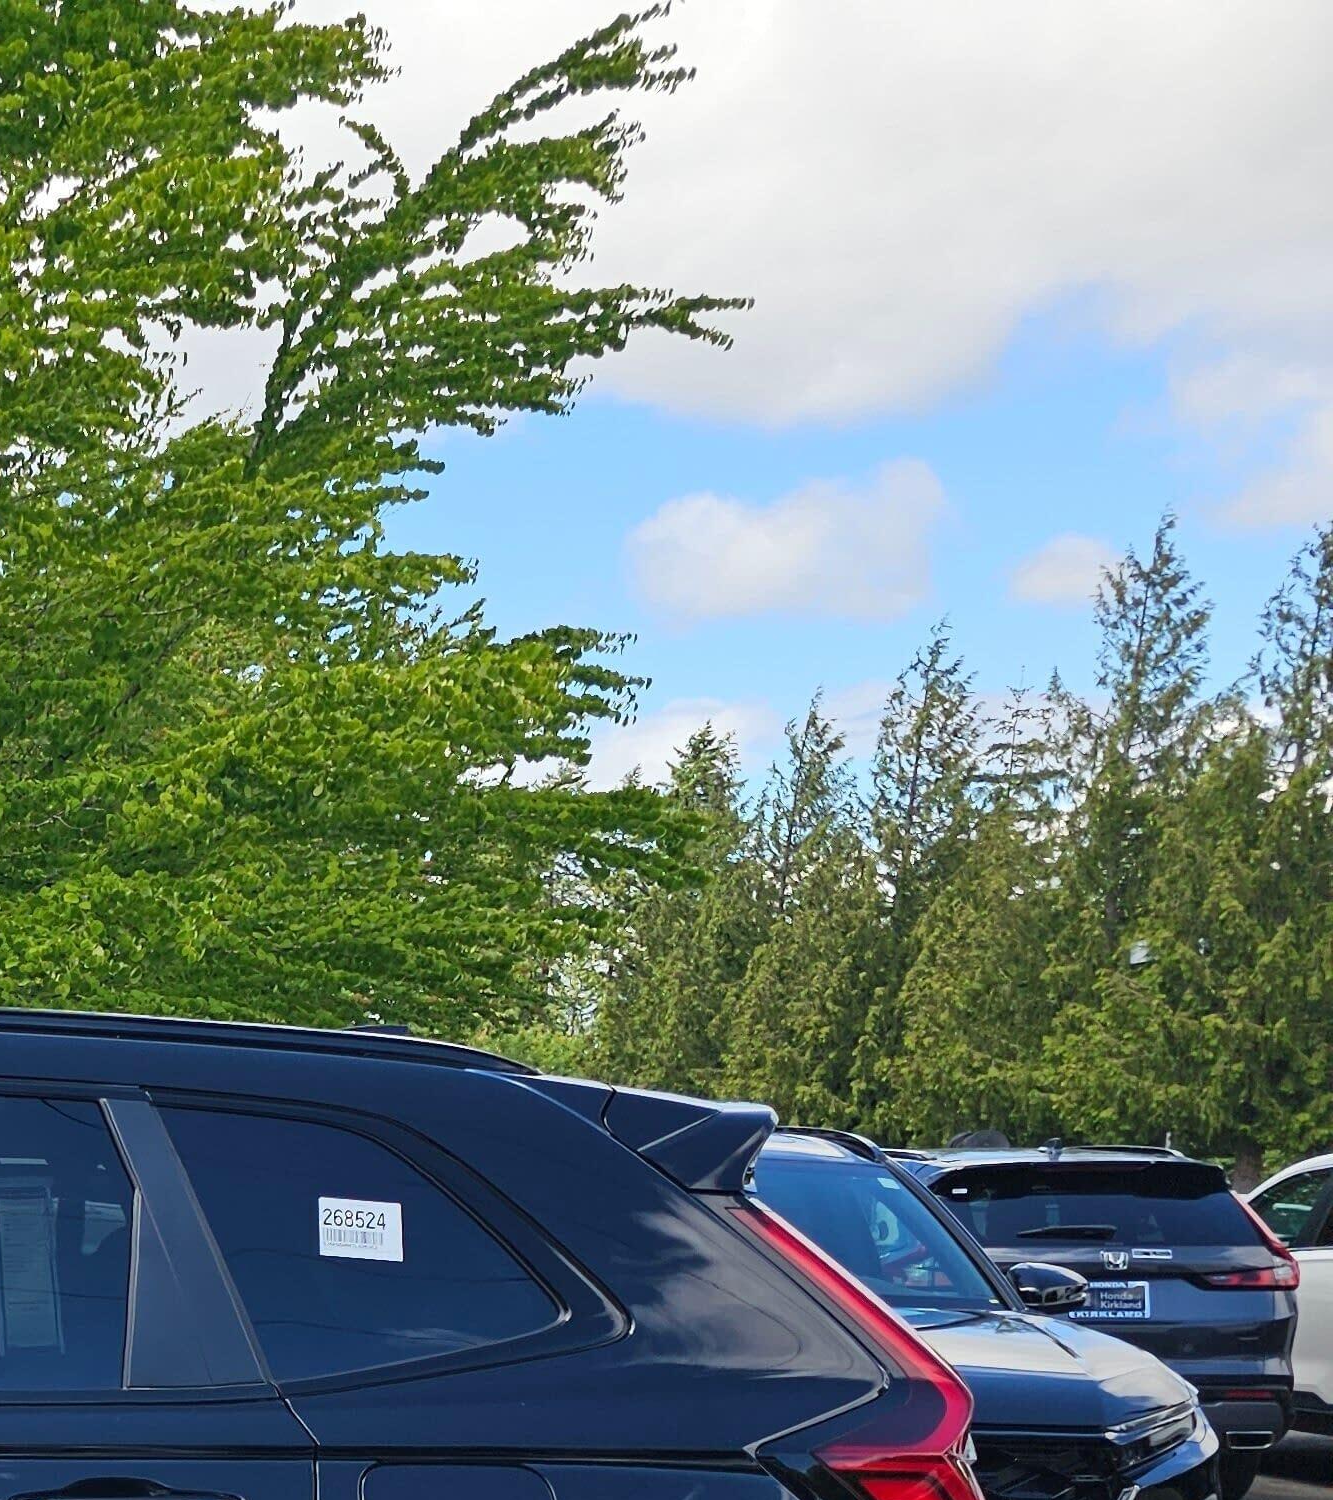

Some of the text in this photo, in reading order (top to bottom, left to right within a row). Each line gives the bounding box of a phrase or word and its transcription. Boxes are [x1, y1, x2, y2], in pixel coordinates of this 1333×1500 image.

[323, 1208, 386, 1230] 268524
[1100, 1292, 1134, 1300] Honda
[1100, 1301, 1142, 1310] Kirkland
